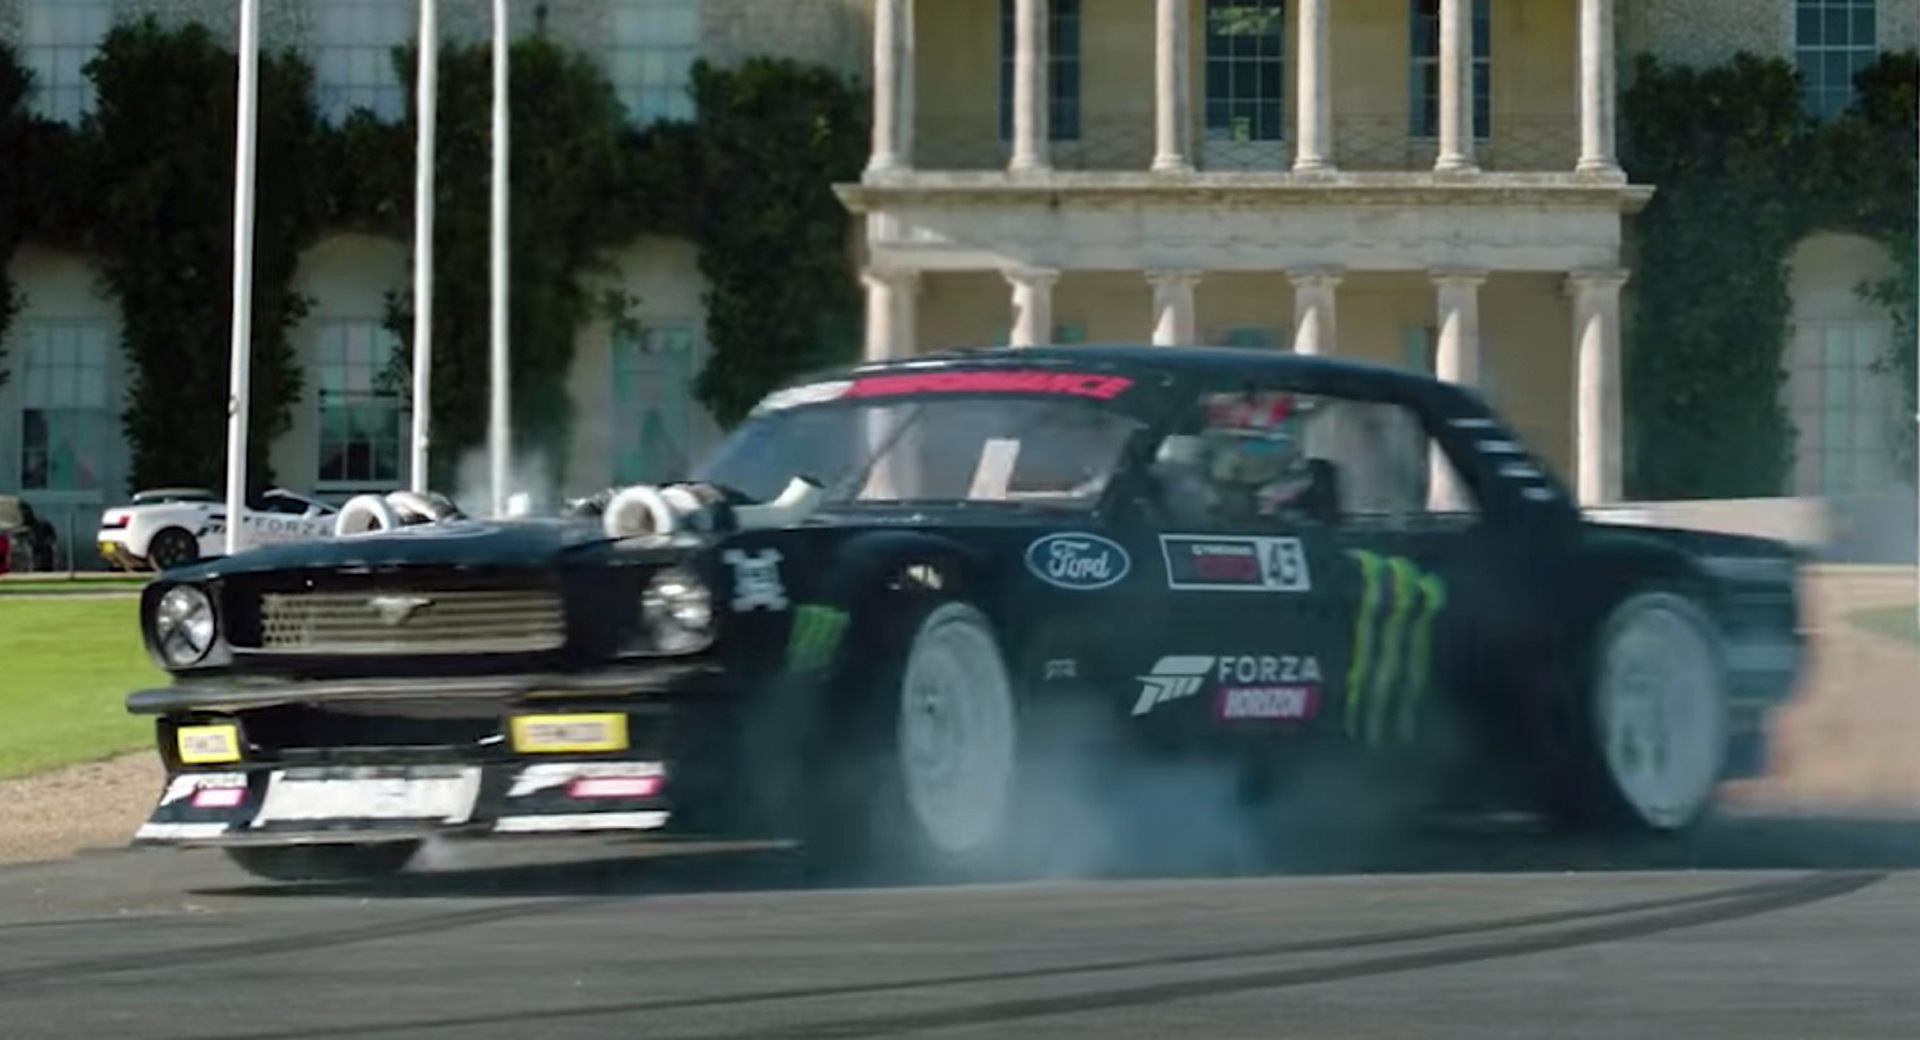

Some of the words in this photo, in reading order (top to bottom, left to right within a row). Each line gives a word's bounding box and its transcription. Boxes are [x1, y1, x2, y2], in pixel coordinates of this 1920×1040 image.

[1047, 540, 1111, 578] Ford
[1268, 542, 1299, 586] 43
[1218, 655, 1323, 683] FORZA
